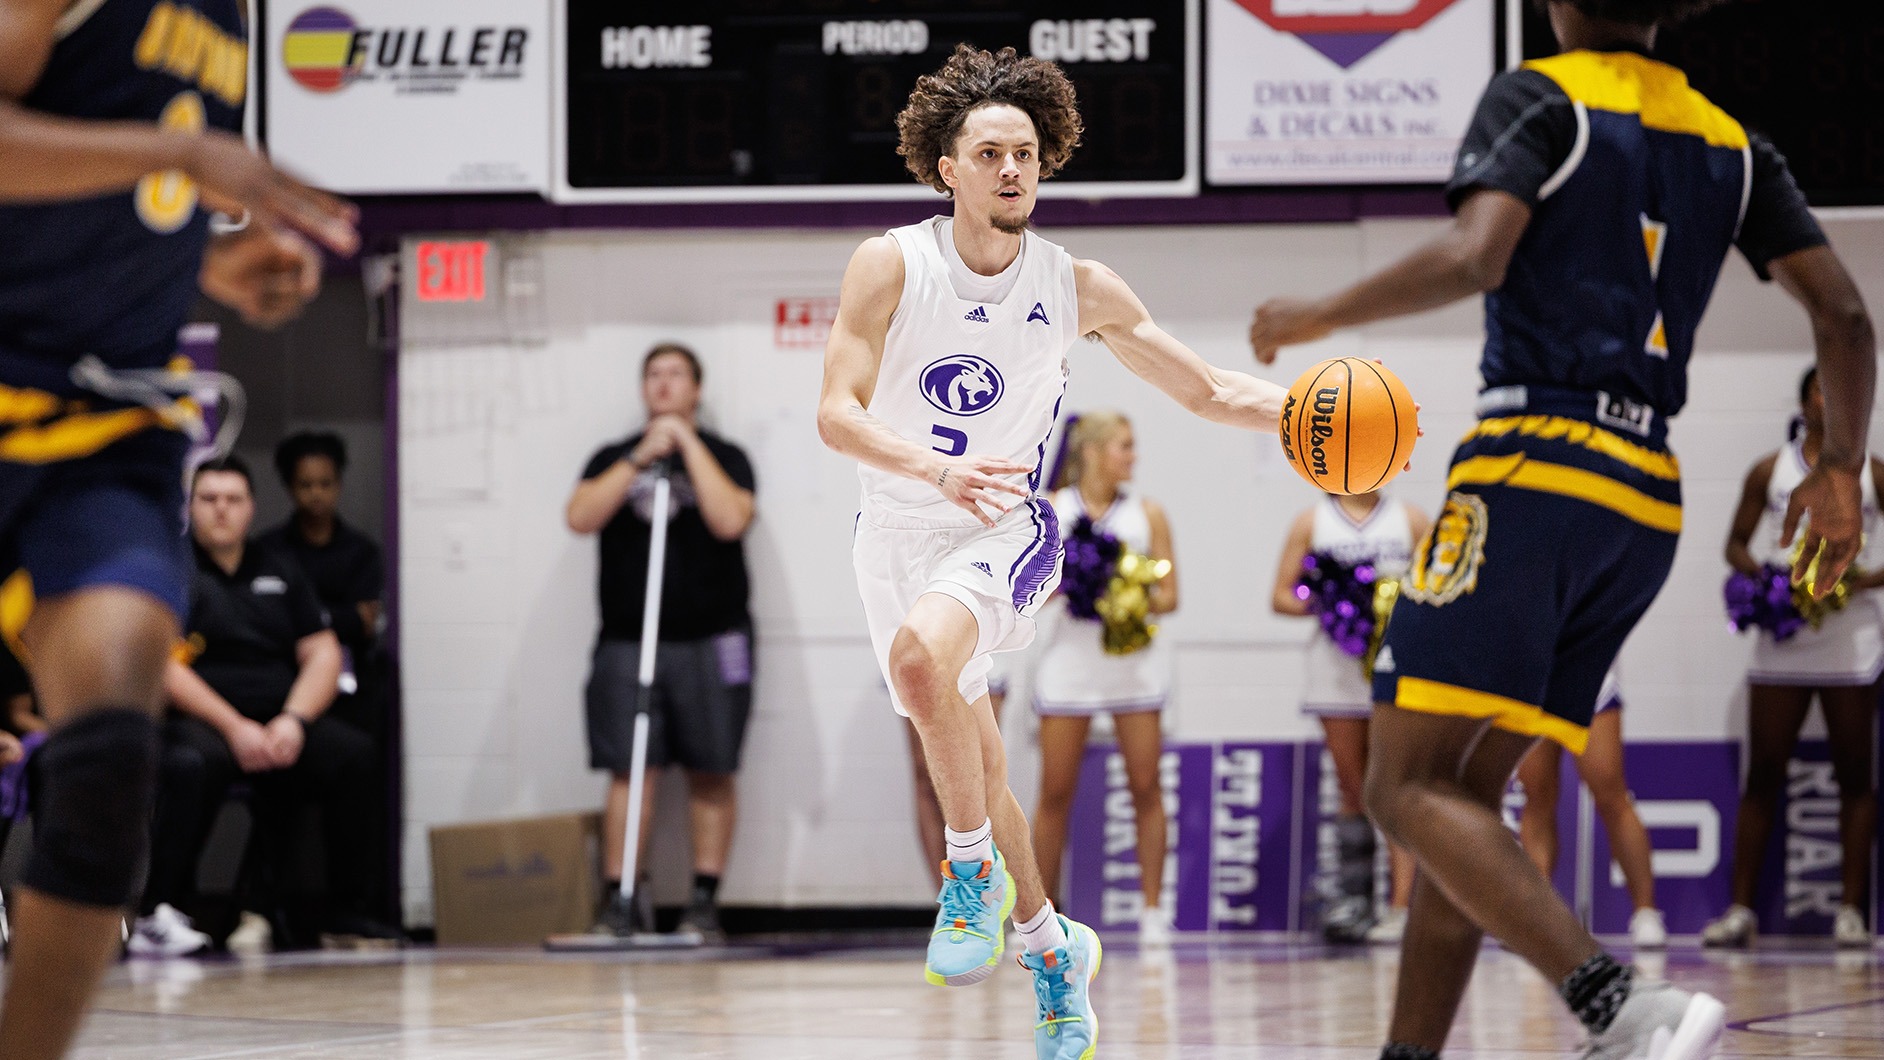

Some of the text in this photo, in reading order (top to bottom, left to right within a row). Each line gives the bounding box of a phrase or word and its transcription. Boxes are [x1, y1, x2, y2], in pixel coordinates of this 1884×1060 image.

[346, 28, 528, 67] FULLER
[602, 26, 712, 68] HOME
[822, 20, 929, 55] PERIOD
[1029, 18, 1156, 62] GUEST
[1345, 78, 1440, 104] SIGNS
[1280, 113, 1396, 137] DECALS
[417, 241, 489, 301] EXIT
[964, 314, 989, 323] adidas
[1310, 386, 1339, 476] Wilson
